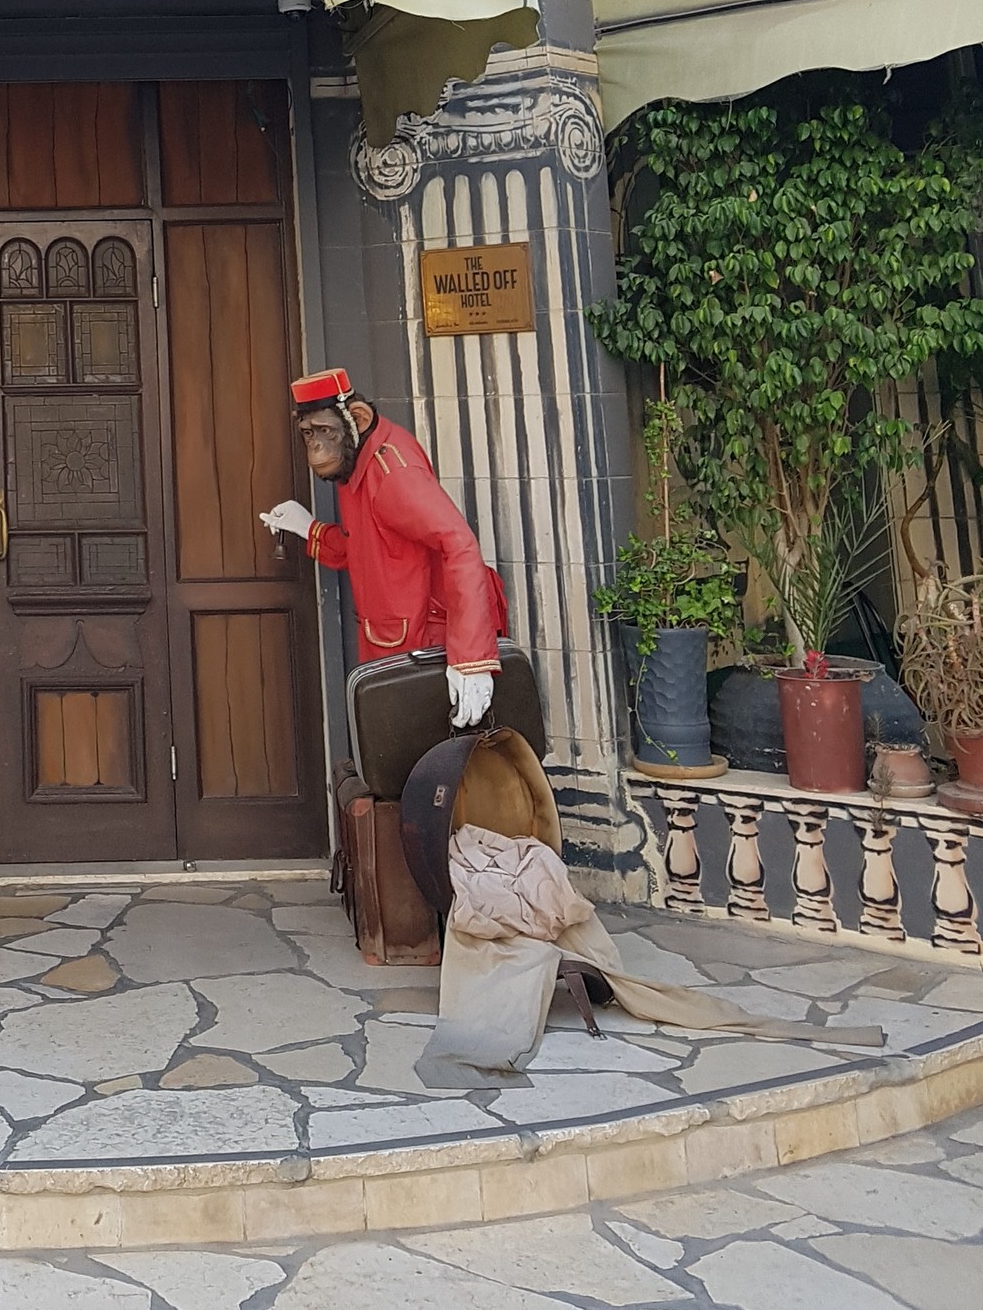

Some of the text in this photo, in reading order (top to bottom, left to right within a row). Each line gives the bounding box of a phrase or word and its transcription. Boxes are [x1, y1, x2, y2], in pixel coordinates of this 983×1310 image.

[464, 256, 483, 271] THE
[434, 269, 517, 294] WALLED OFF
[460, 292, 492, 308] HOTEL
